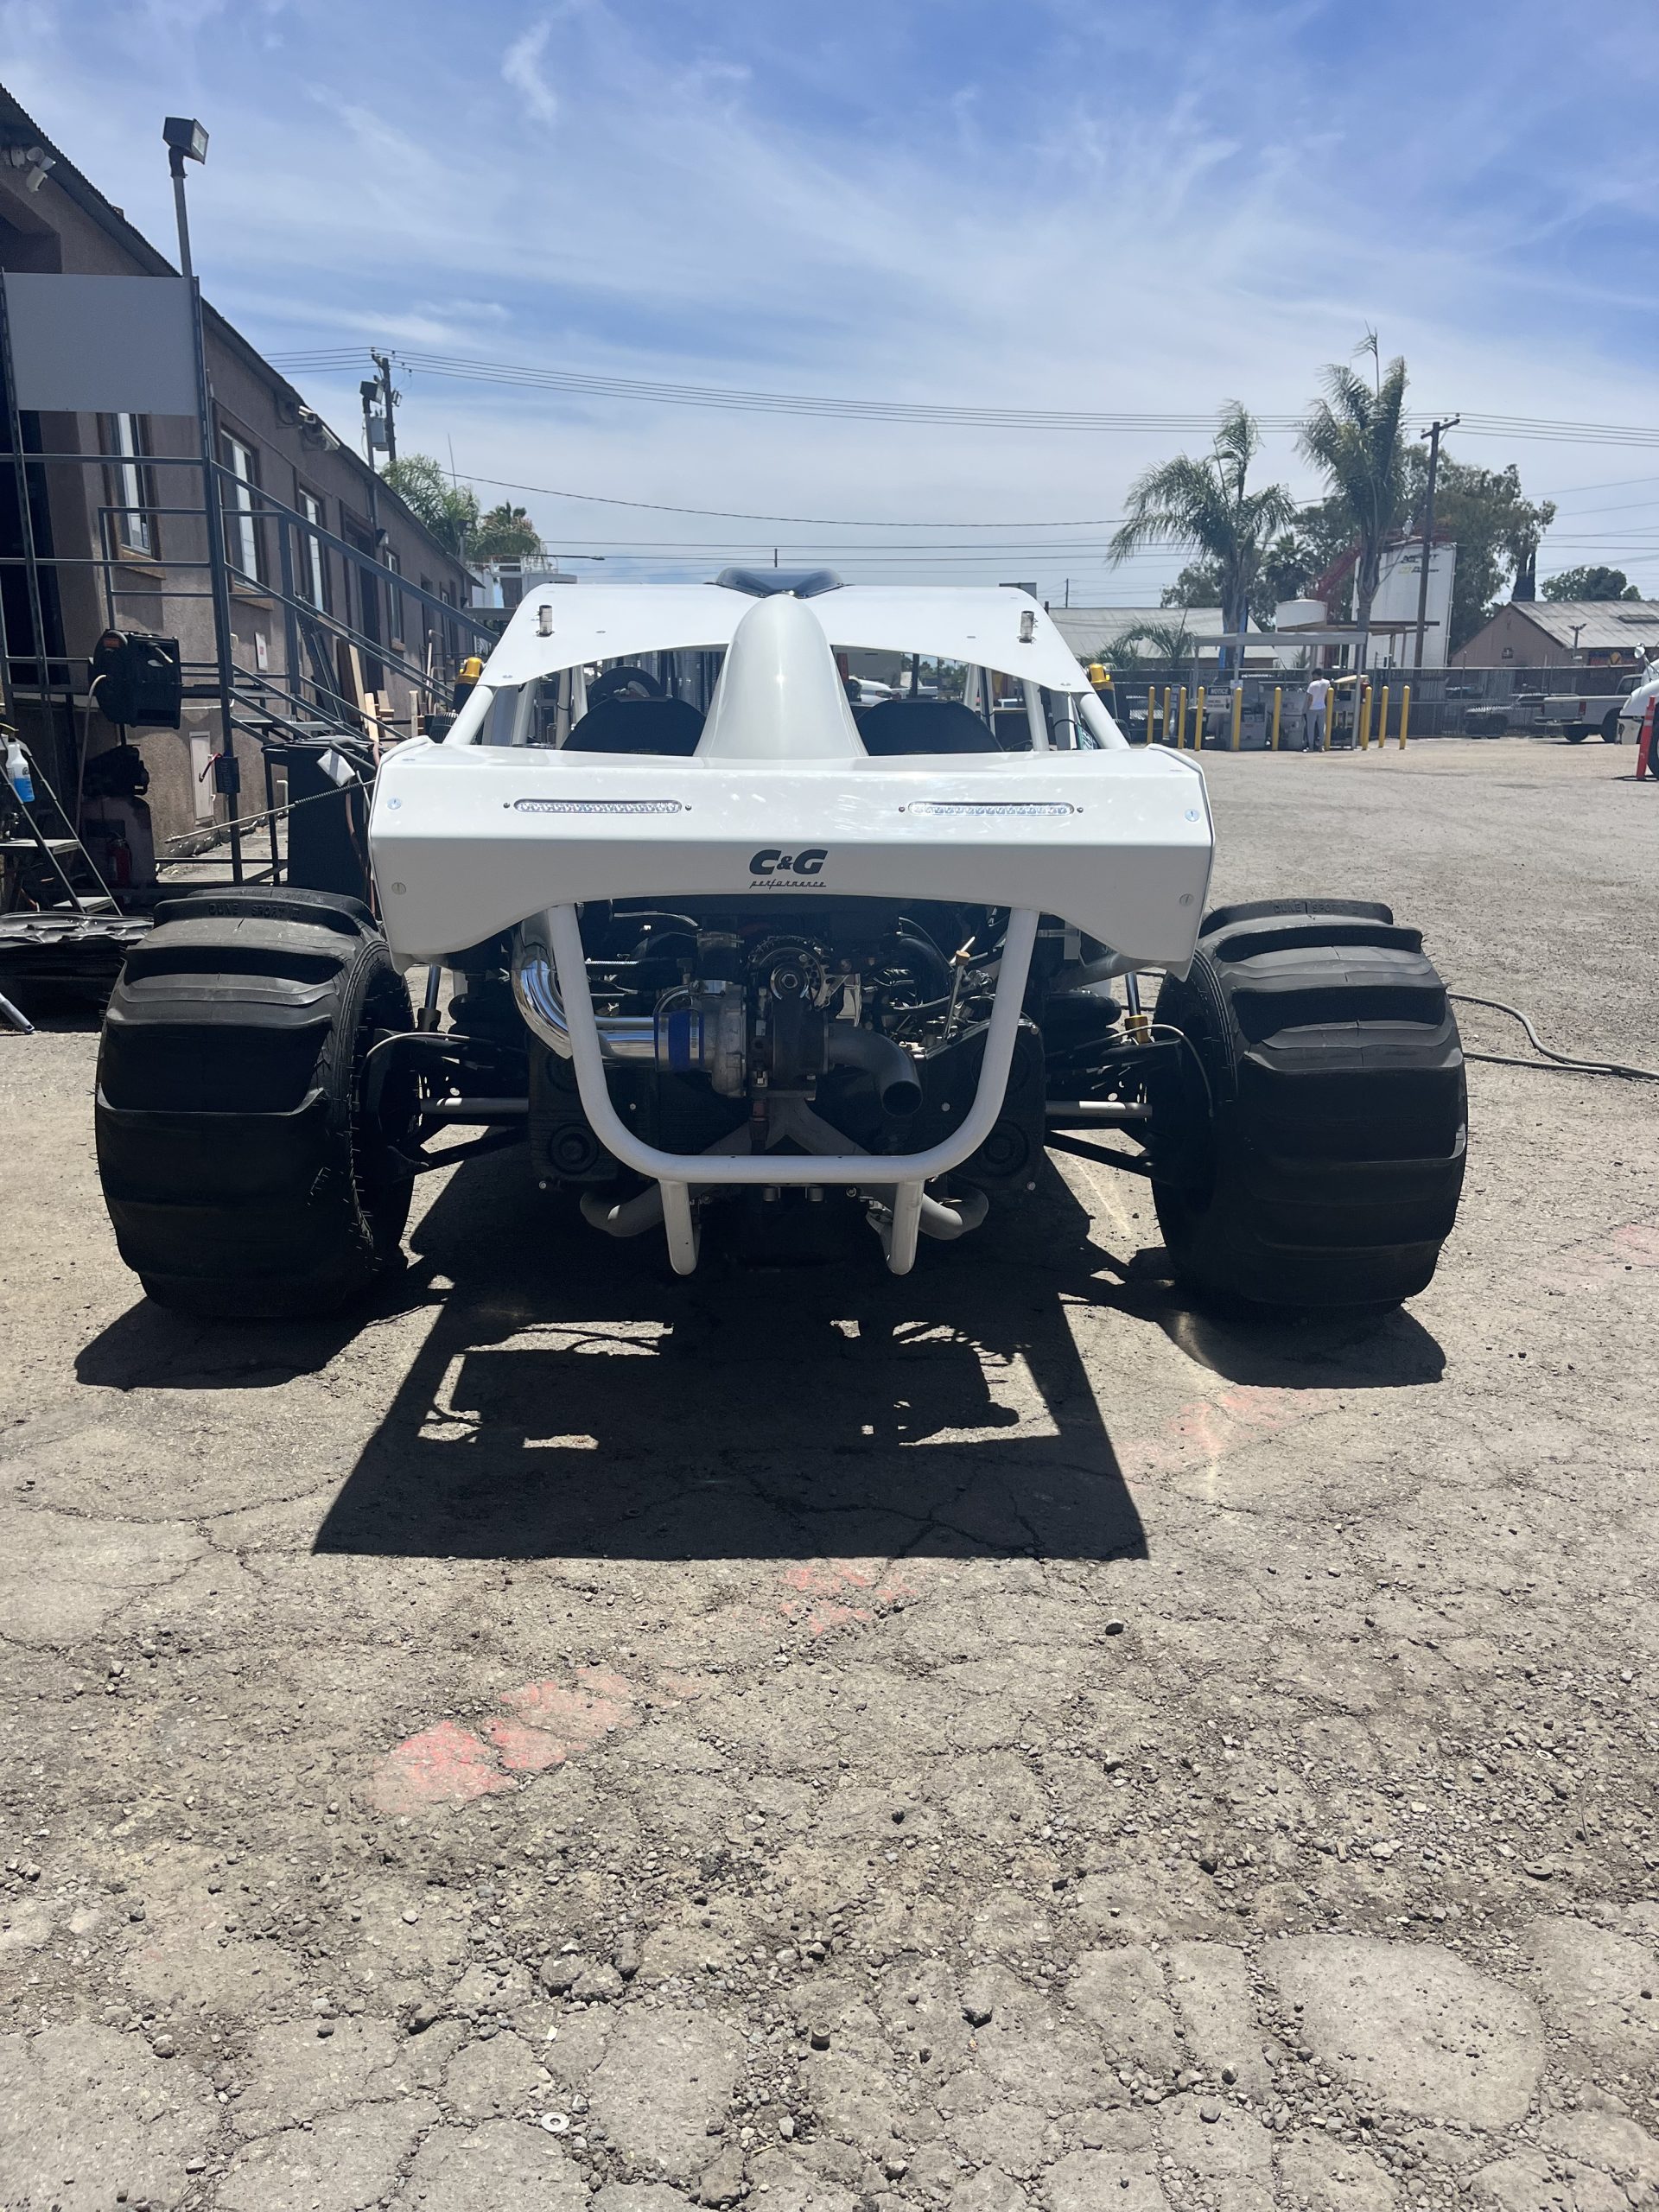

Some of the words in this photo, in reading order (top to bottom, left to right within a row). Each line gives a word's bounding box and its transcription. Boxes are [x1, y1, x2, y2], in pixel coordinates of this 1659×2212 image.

[749, 849, 828, 875] C&G
[749, 879, 827, 890] performance
[208, 903, 238, 916] DUNE
[1274, 903, 1301, 914] DUNE
